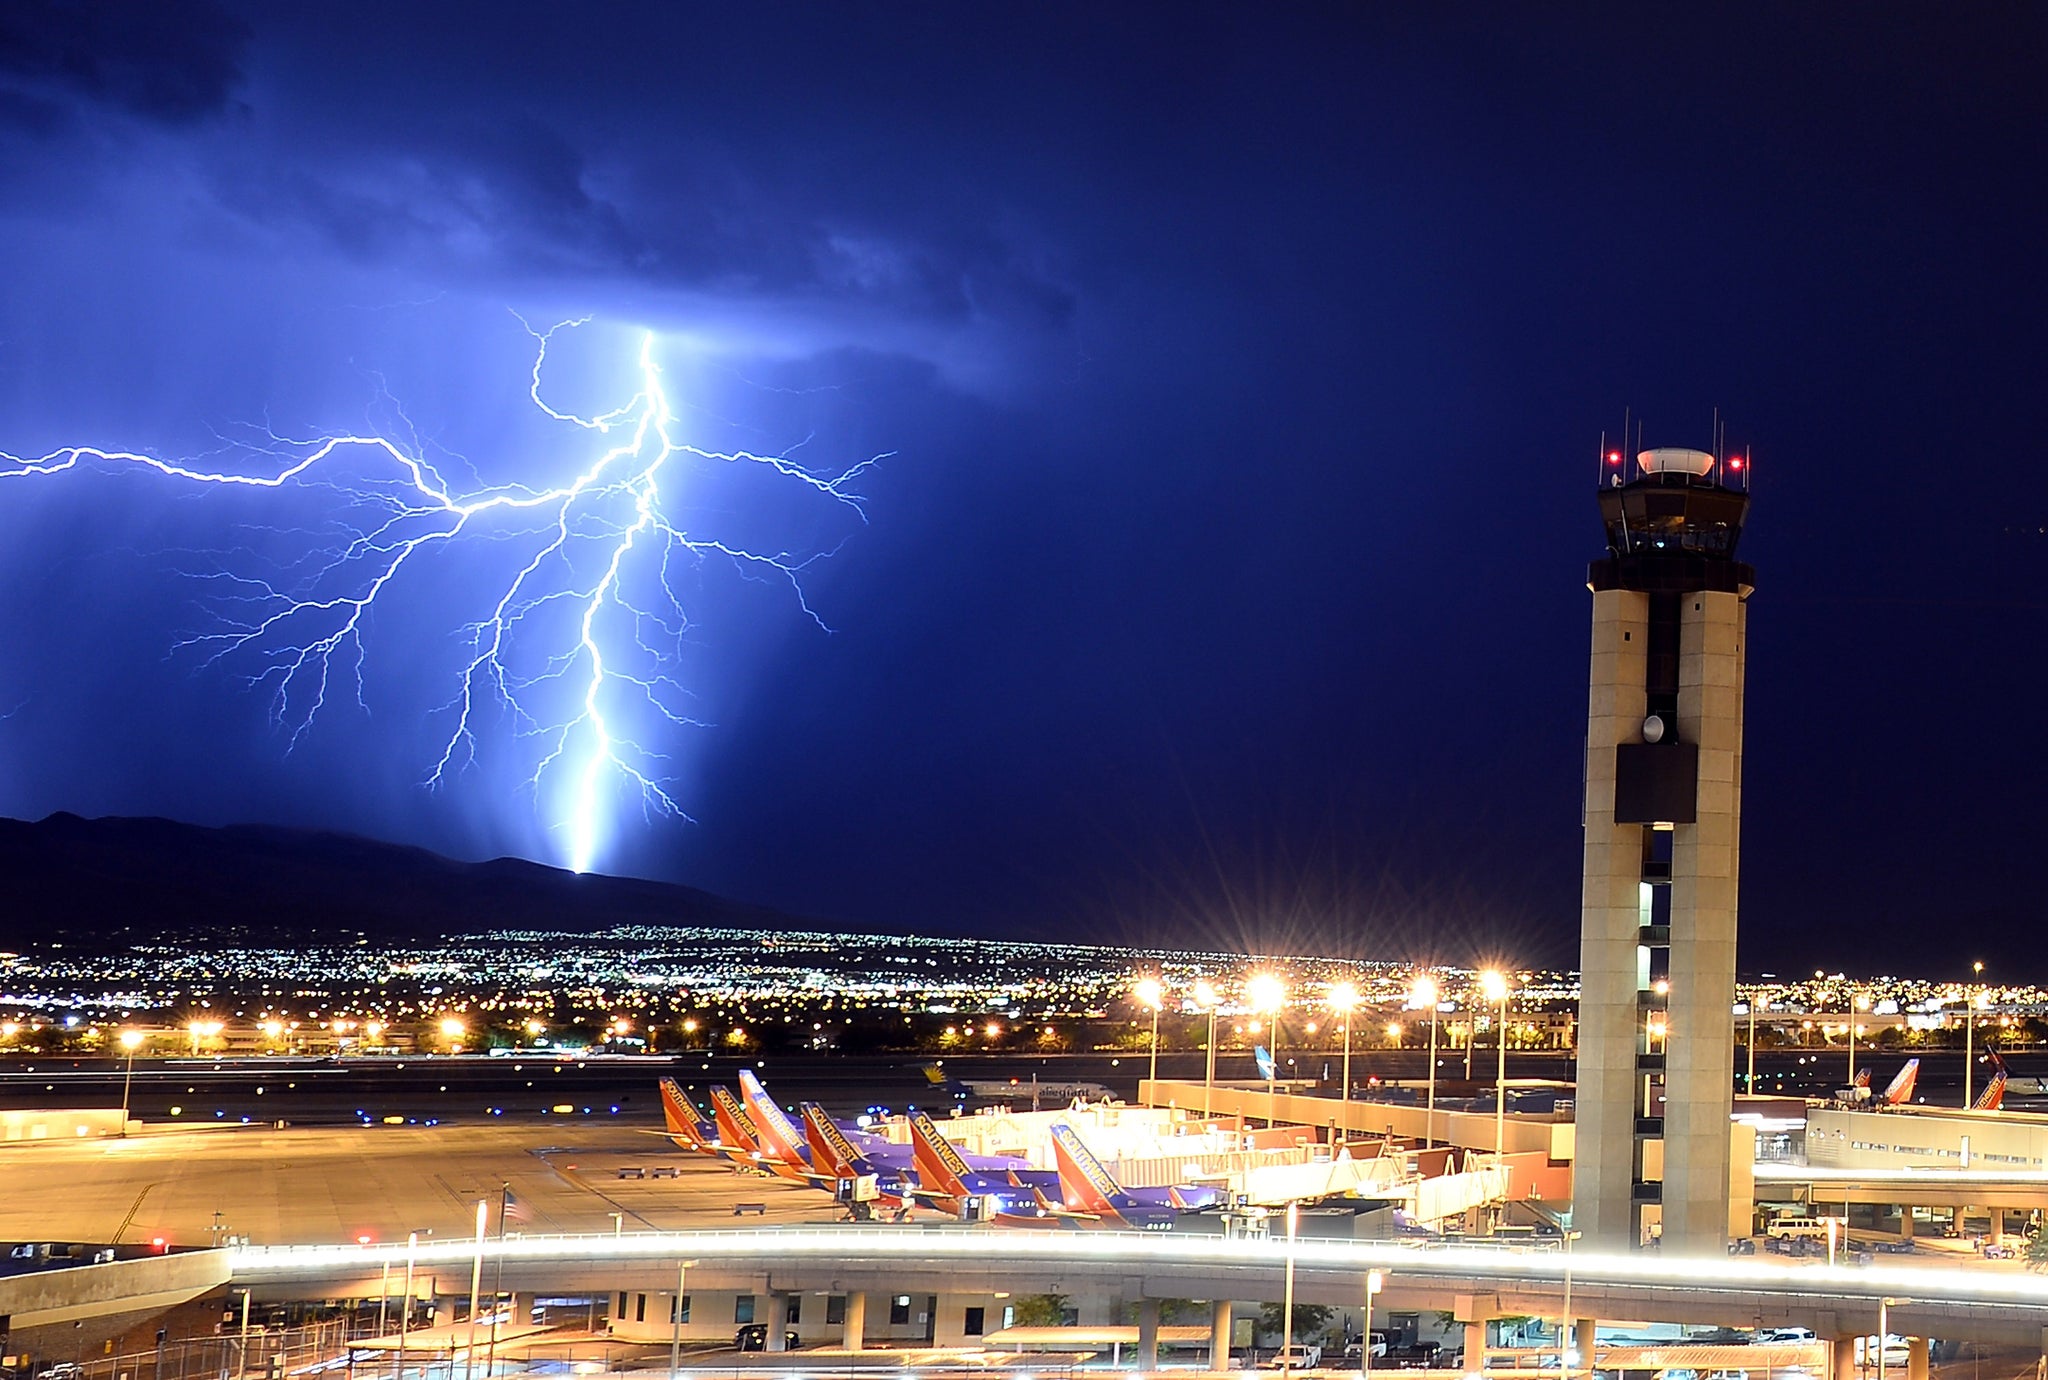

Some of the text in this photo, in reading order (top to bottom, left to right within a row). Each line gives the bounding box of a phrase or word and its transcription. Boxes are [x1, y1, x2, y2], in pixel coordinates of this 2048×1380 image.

[666, 1080, 701, 1124] SOUTHWEST
[717, 1089, 758, 1137] SOUTHWEST
[1039, 1085, 1090, 1097] allegiant
[759, 1098, 804, 1149] SOUTHWEST
[812, 1107, 859, 1163] SOUTHWEST
[915, 1115, 970, 1177] SOUTHWEST
[1063, 1129, 1120, 1198] SOUTHWEST
